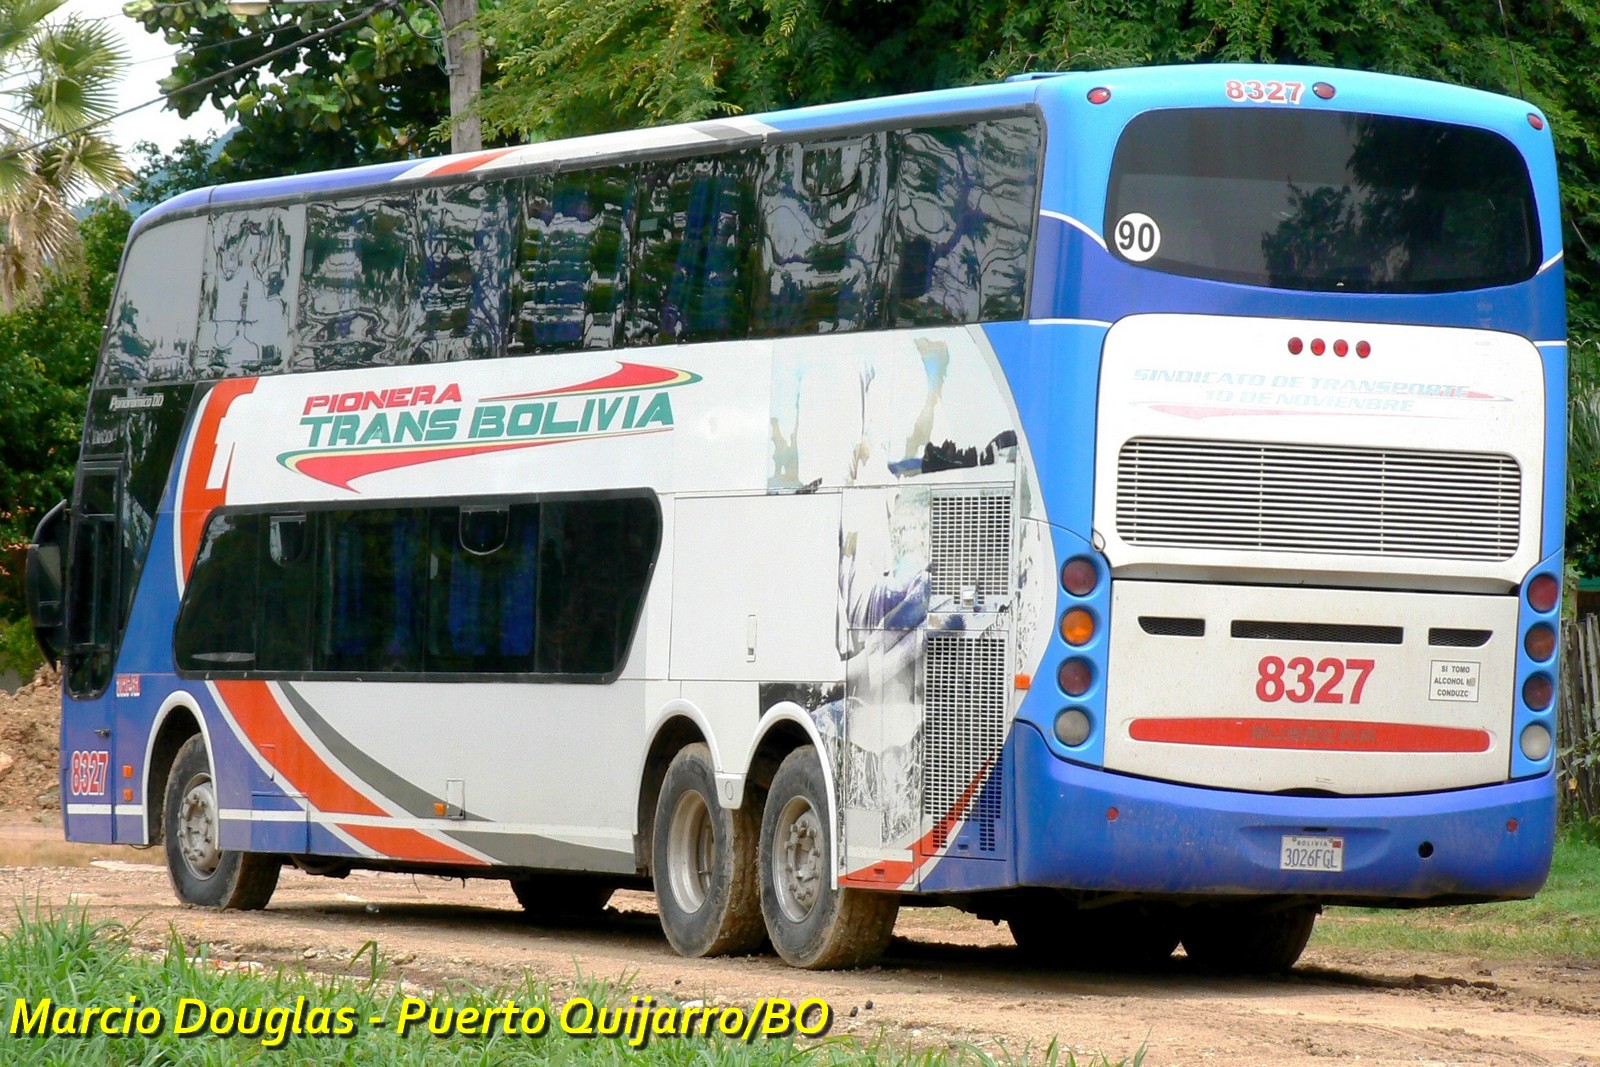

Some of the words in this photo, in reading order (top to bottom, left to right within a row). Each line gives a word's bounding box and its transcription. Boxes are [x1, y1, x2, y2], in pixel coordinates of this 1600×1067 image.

[1225, 79, 1305, 105] 8327
[1118, 220, 1155, 253] 90
[1133, 368, 1265, 388] SINDICATO
[1271, 375, 1306, 390] DE
[1311, 378, 1472, 398] TRANSPORTE
[302, 383, 462, 416] PIONERA
[1204, 389, 1233, 403] 10
[1239, 391, 1274, 405] DE
[1278, 394, 1416, 412] NOVIENBRE
[300, 407, 462, 448] TRANS
[467, 391, 674, 439] BOLIVIA
[1255, 655, 1376, 705] 8327
[1434, 677, 1465, 686] ALCOHOL
[1441, 665, 1448, 673] SI
[1451, 665, 1471, 674] TOMO
[71, 750, 109, 796] 8327
